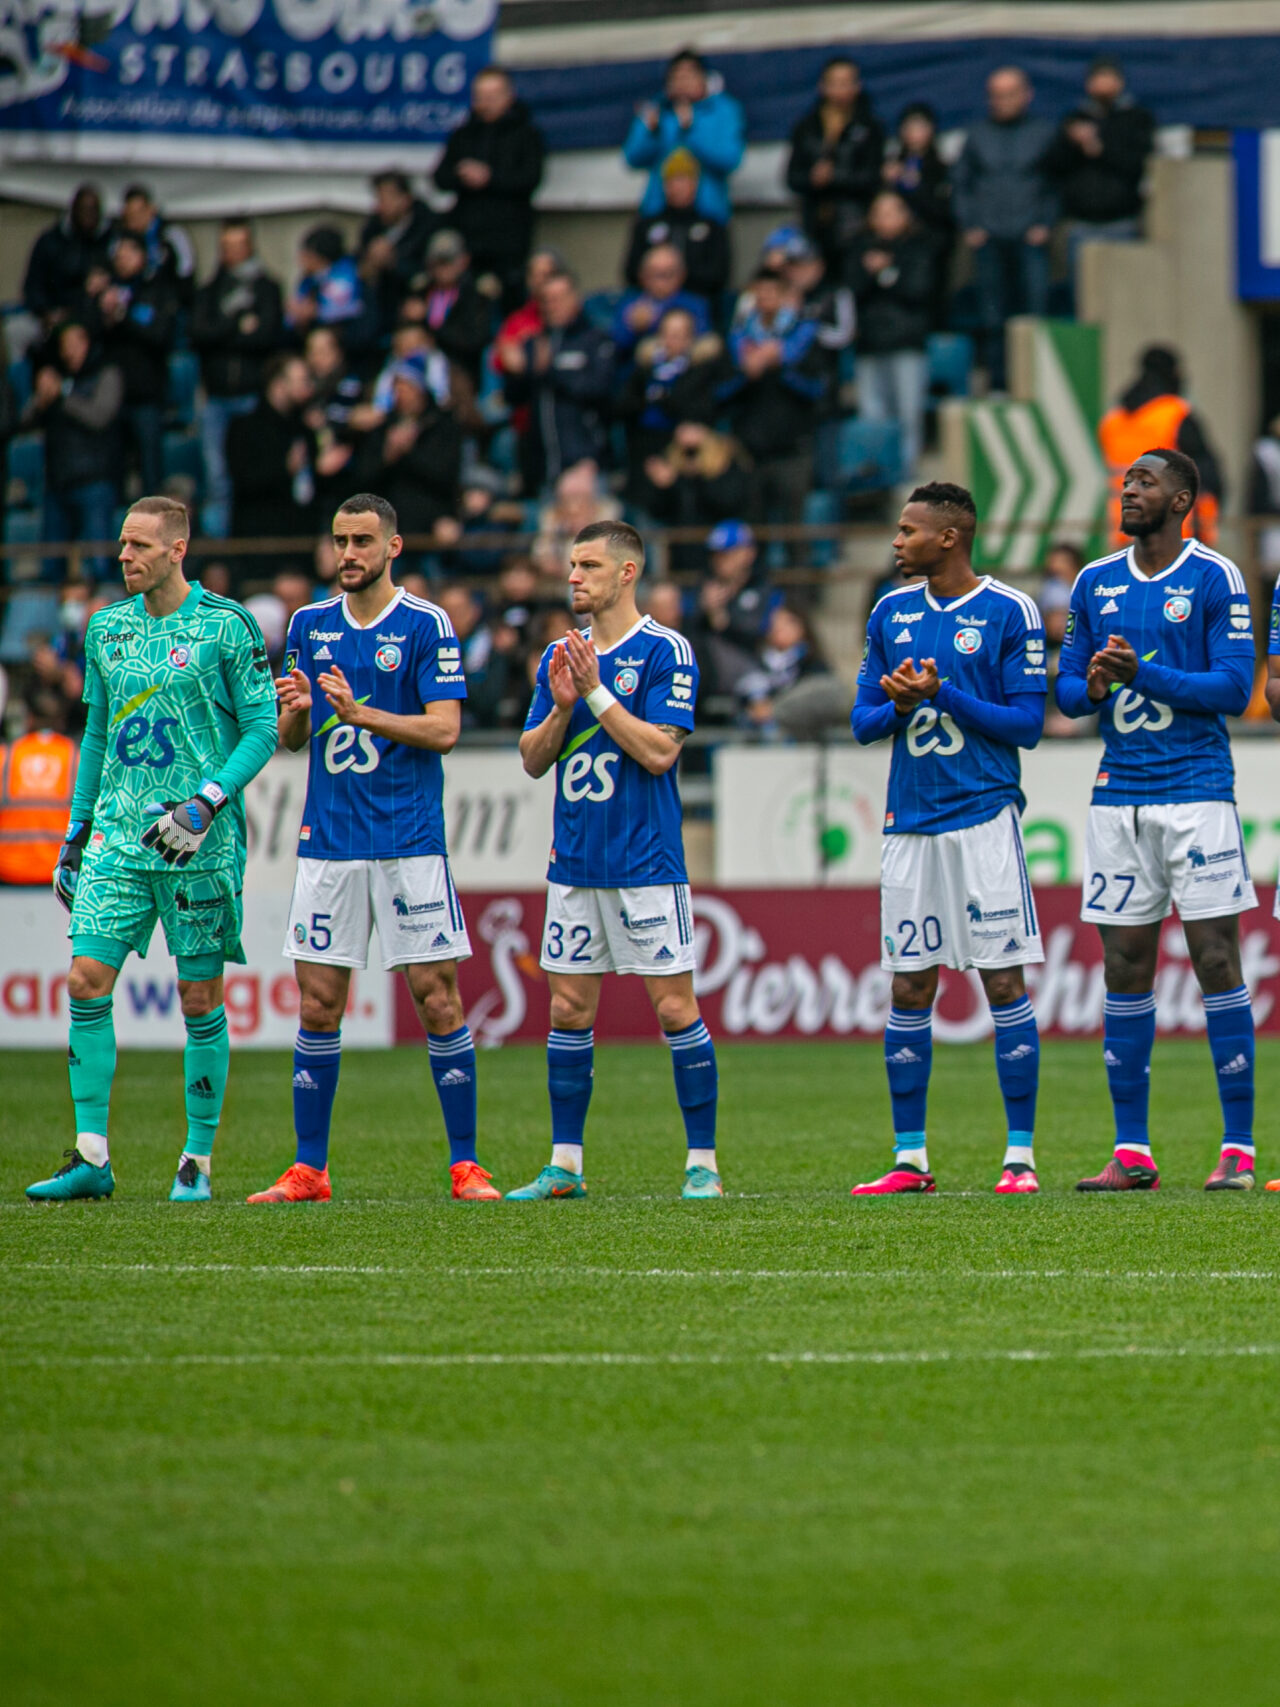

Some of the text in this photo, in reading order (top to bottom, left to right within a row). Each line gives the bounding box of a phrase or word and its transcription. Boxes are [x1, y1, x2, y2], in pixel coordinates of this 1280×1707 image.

[120, 43, 467, 94] STRASBOURG
[116, 716, 178, 769] es
[562, 752, 619, 802] es
[408, 900, 445, 913] SOPREMA
[1086, 872, 1136, 913] 27
[310, 914, 331, 951] 5
[547, 921, 592, 961] 32
[898, 915, 943, 957] 20
